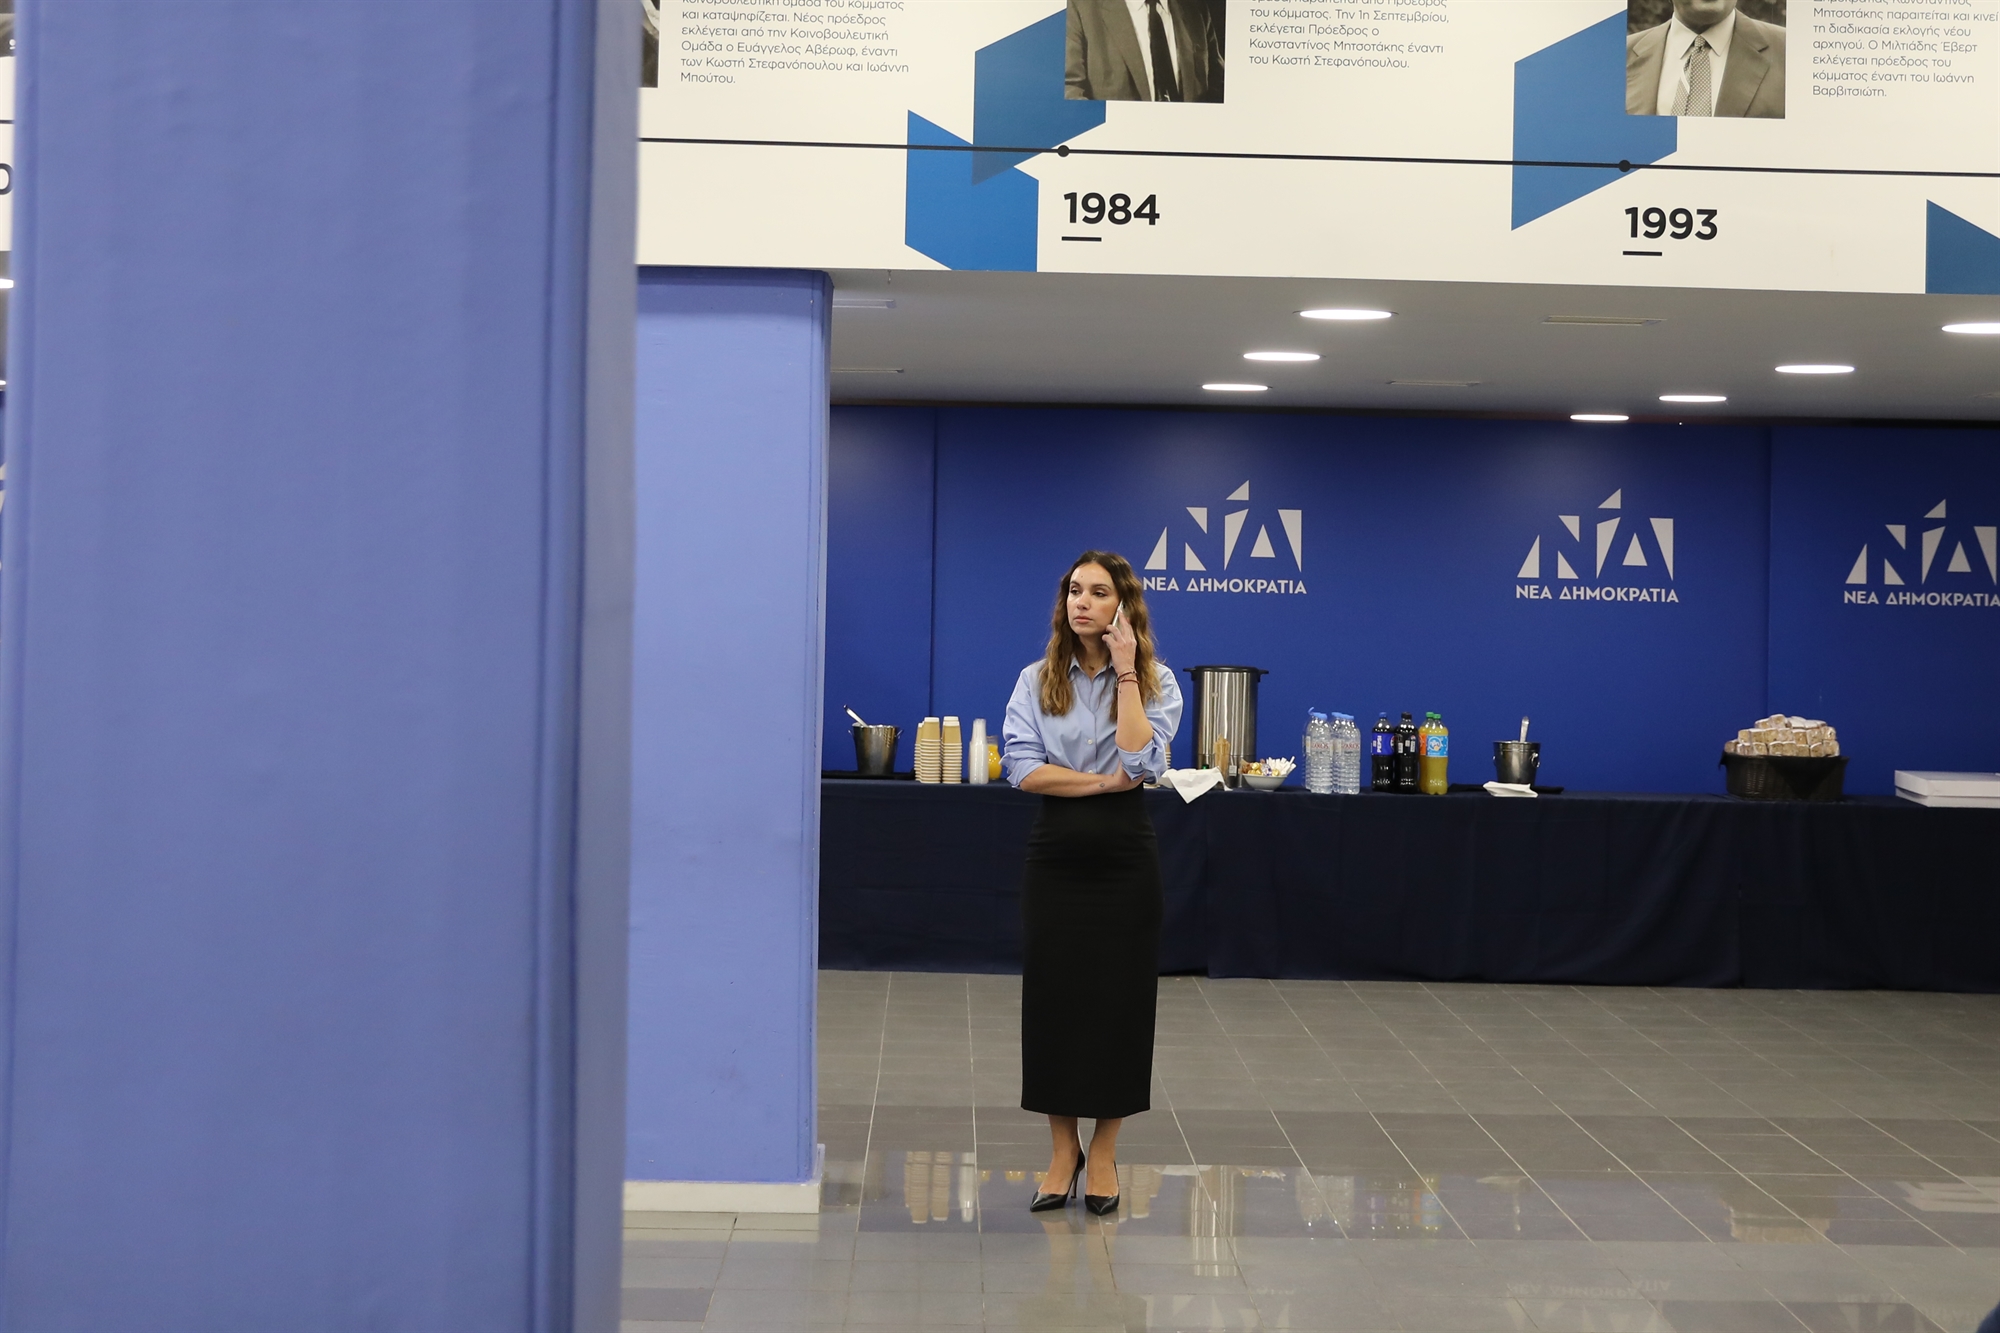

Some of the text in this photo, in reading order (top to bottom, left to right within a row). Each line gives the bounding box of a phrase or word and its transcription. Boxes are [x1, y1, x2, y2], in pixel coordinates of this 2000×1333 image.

[824, 0, 845, 8] του
[682, 10, 886, 27] και καταψηφίζεται. Νέος πρόεδρος
[1249, 8, 1270, 17] του
[1272, 7, 1332, 20] κόμματος.
[1334, 8, 1356, 20] Την
[1373, 10, 1449, 23] Σεπτεμβρίου,
[1813, 7, 1999, 22] Μητσοτάκης παραιτείται και κινεί
[681, 25, 889, 41] εκλέγεται από την Κοινοβουλευτική
[1249, 23, 1380, 37] εκλέγεται Πρόεδρος ο
[1813, 22, 1971, 37] τη διαδικασία εκλογής νέου
[681, 40, 898, 57] Ομάδα ο Ευάγγελος Αβέρωφ, έναντι
[1249, 38, 1443, 54] Κωνσταντίνος Μητσοτάκης έναντι
[1812, 39, 1978, 54] αρχηγού. Ο Μιλτιάδης Έβερτ
[680, 56, 909, 72] των Κωστή Στεφανόπουλου και Ιωάννη
[1248, 54, 1410, 68] του Κωστή Στεφανόπουλου.
[1812, 53, 1951, 69] εκλέγεται πρόεδρος του
[680, 71, 736, 84] Μπούτου.
[1812, 70, 1974, 83] κόμματος έναντι του Ιωάννη
[1812, 84, 1887, 98] Βαρβιτσιώτη.
[1063, 192, 1159, 226] 1984
[1625, 207, 1718, 240] 1993
[1143, 577, 1307, 594] ΝΕΑ ΔΗΜΟΚΡΑΤΙΑ
[1516, 584, 1679, 603] ΝΕΑ ΔΗΜΟΚΡΑΤΙΑ
[1844, 590, 2000, 607] ΝΕΑ ΔΗΜΟΚΡΑΤΙΑ
